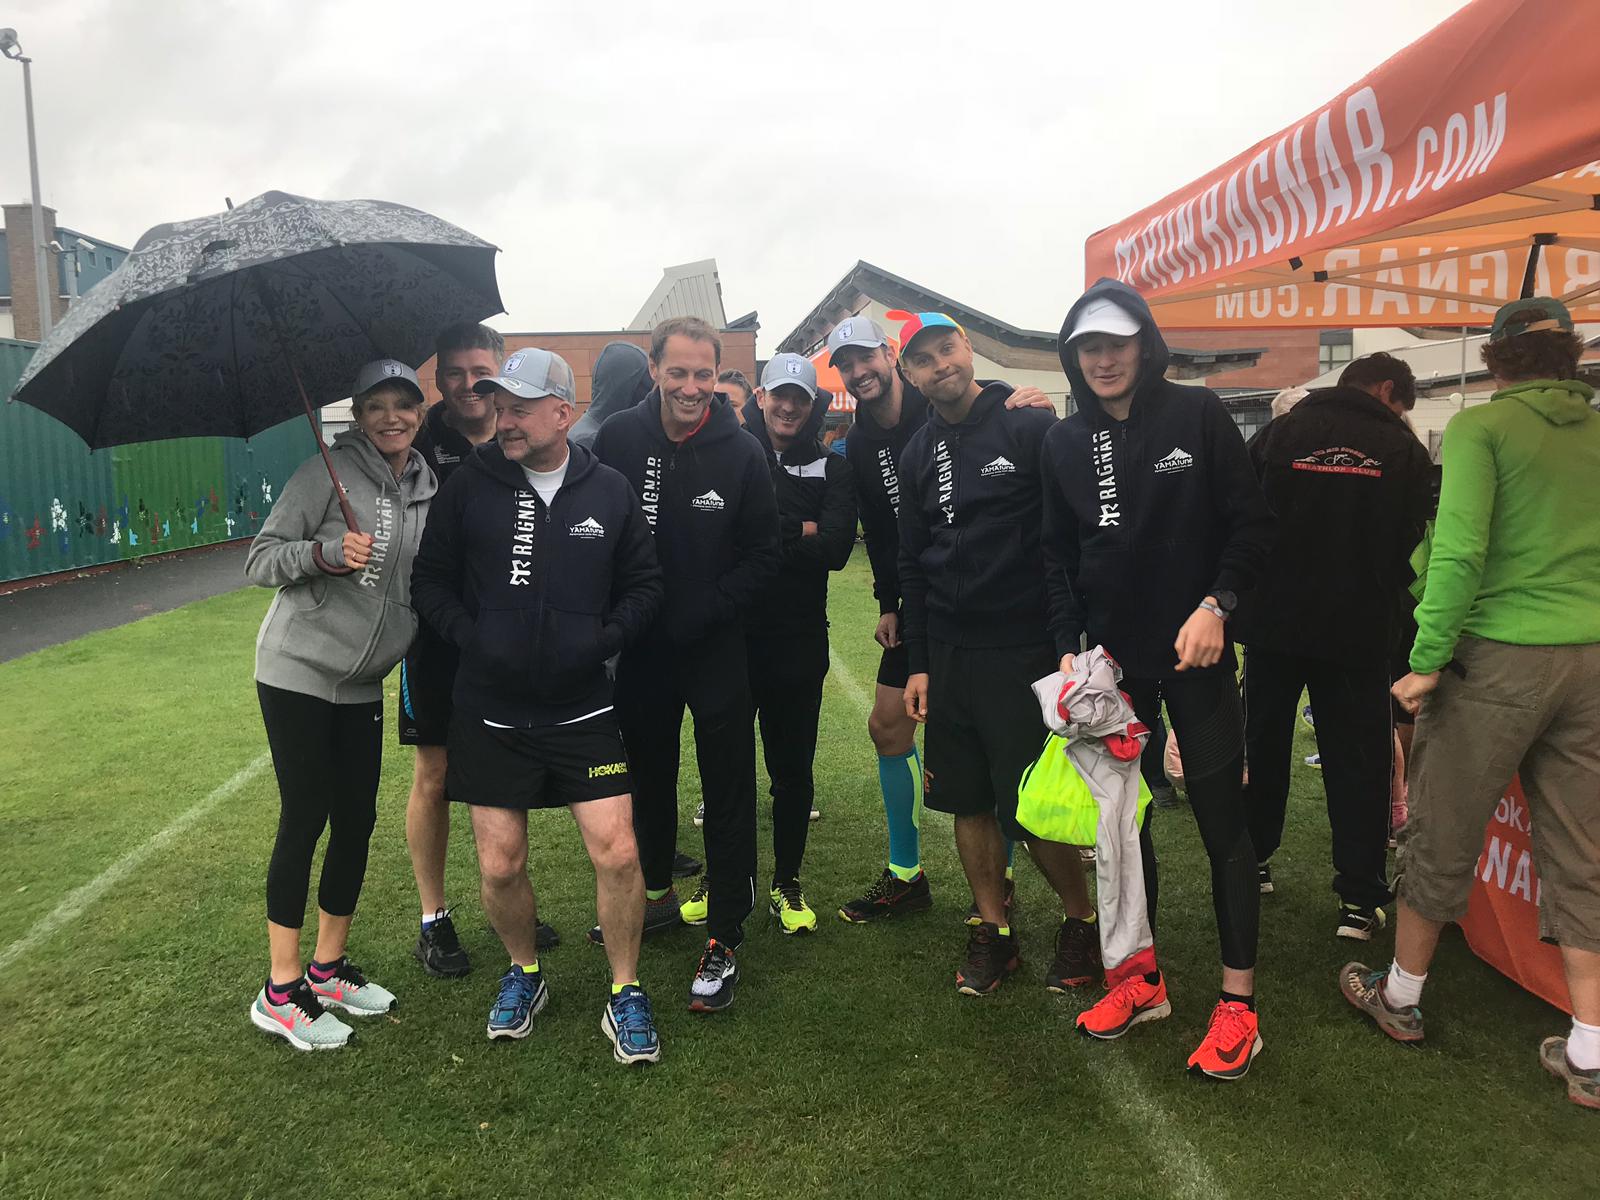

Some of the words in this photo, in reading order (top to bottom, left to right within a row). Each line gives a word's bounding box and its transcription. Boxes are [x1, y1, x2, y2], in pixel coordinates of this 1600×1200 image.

[828, 391, 858, 410] UN
[588, 763, 620, 778] HOKA
[1474, 836, 1541, 906] NA
